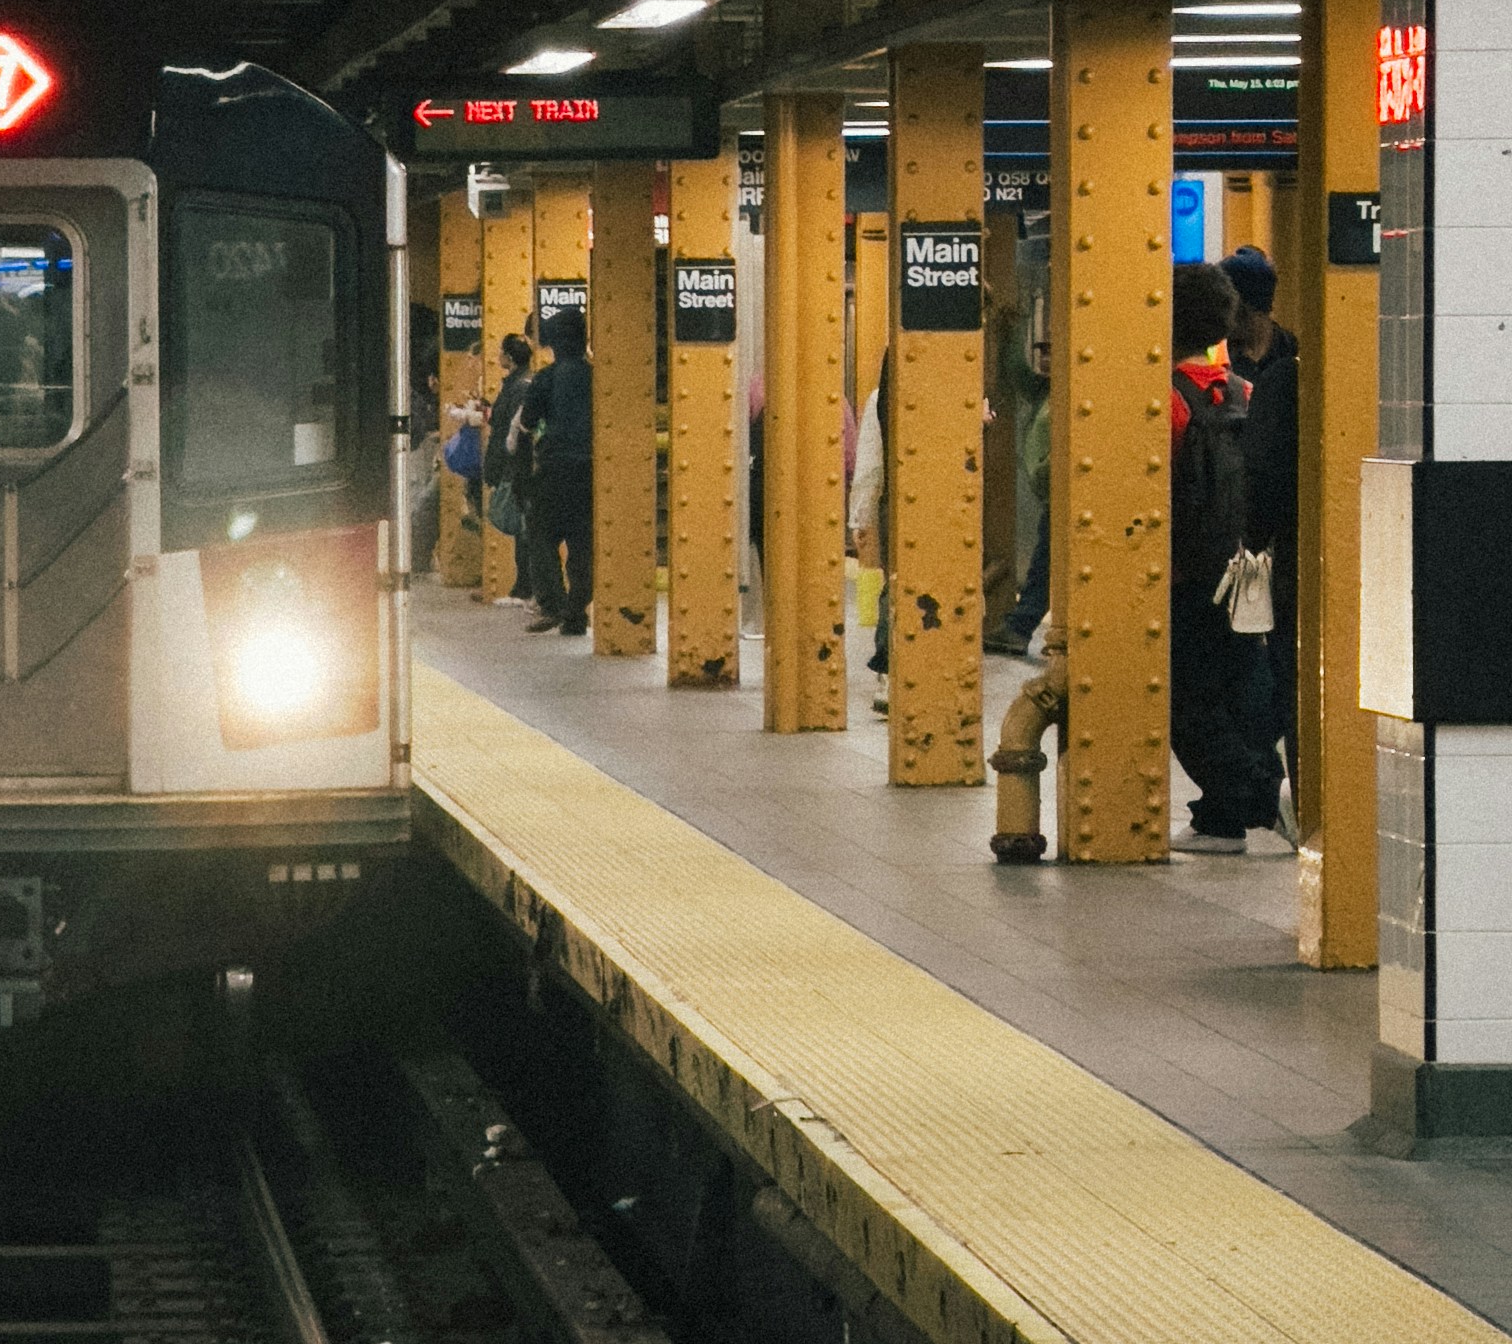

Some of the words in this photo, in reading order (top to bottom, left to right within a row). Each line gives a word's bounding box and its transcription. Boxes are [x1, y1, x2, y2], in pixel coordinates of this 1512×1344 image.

[1229, 79, 1248, 89] May
[464, 101, 518, 122] NEXT
[530, 100, 600, 122] TRAIN
[998, 172, 1030, 185] Q58
[996, 188, 1023, 201] N21
[906, 237, 979, 263] Main
[678, 269, 734, 290] Main
[907, 265, 979, 287] Street
[540, 288, 586, 305] Main
[678, 292, 734, 308] Street
[445, 302, 482, 316] Main
[445, 316, 483, 329] Street
